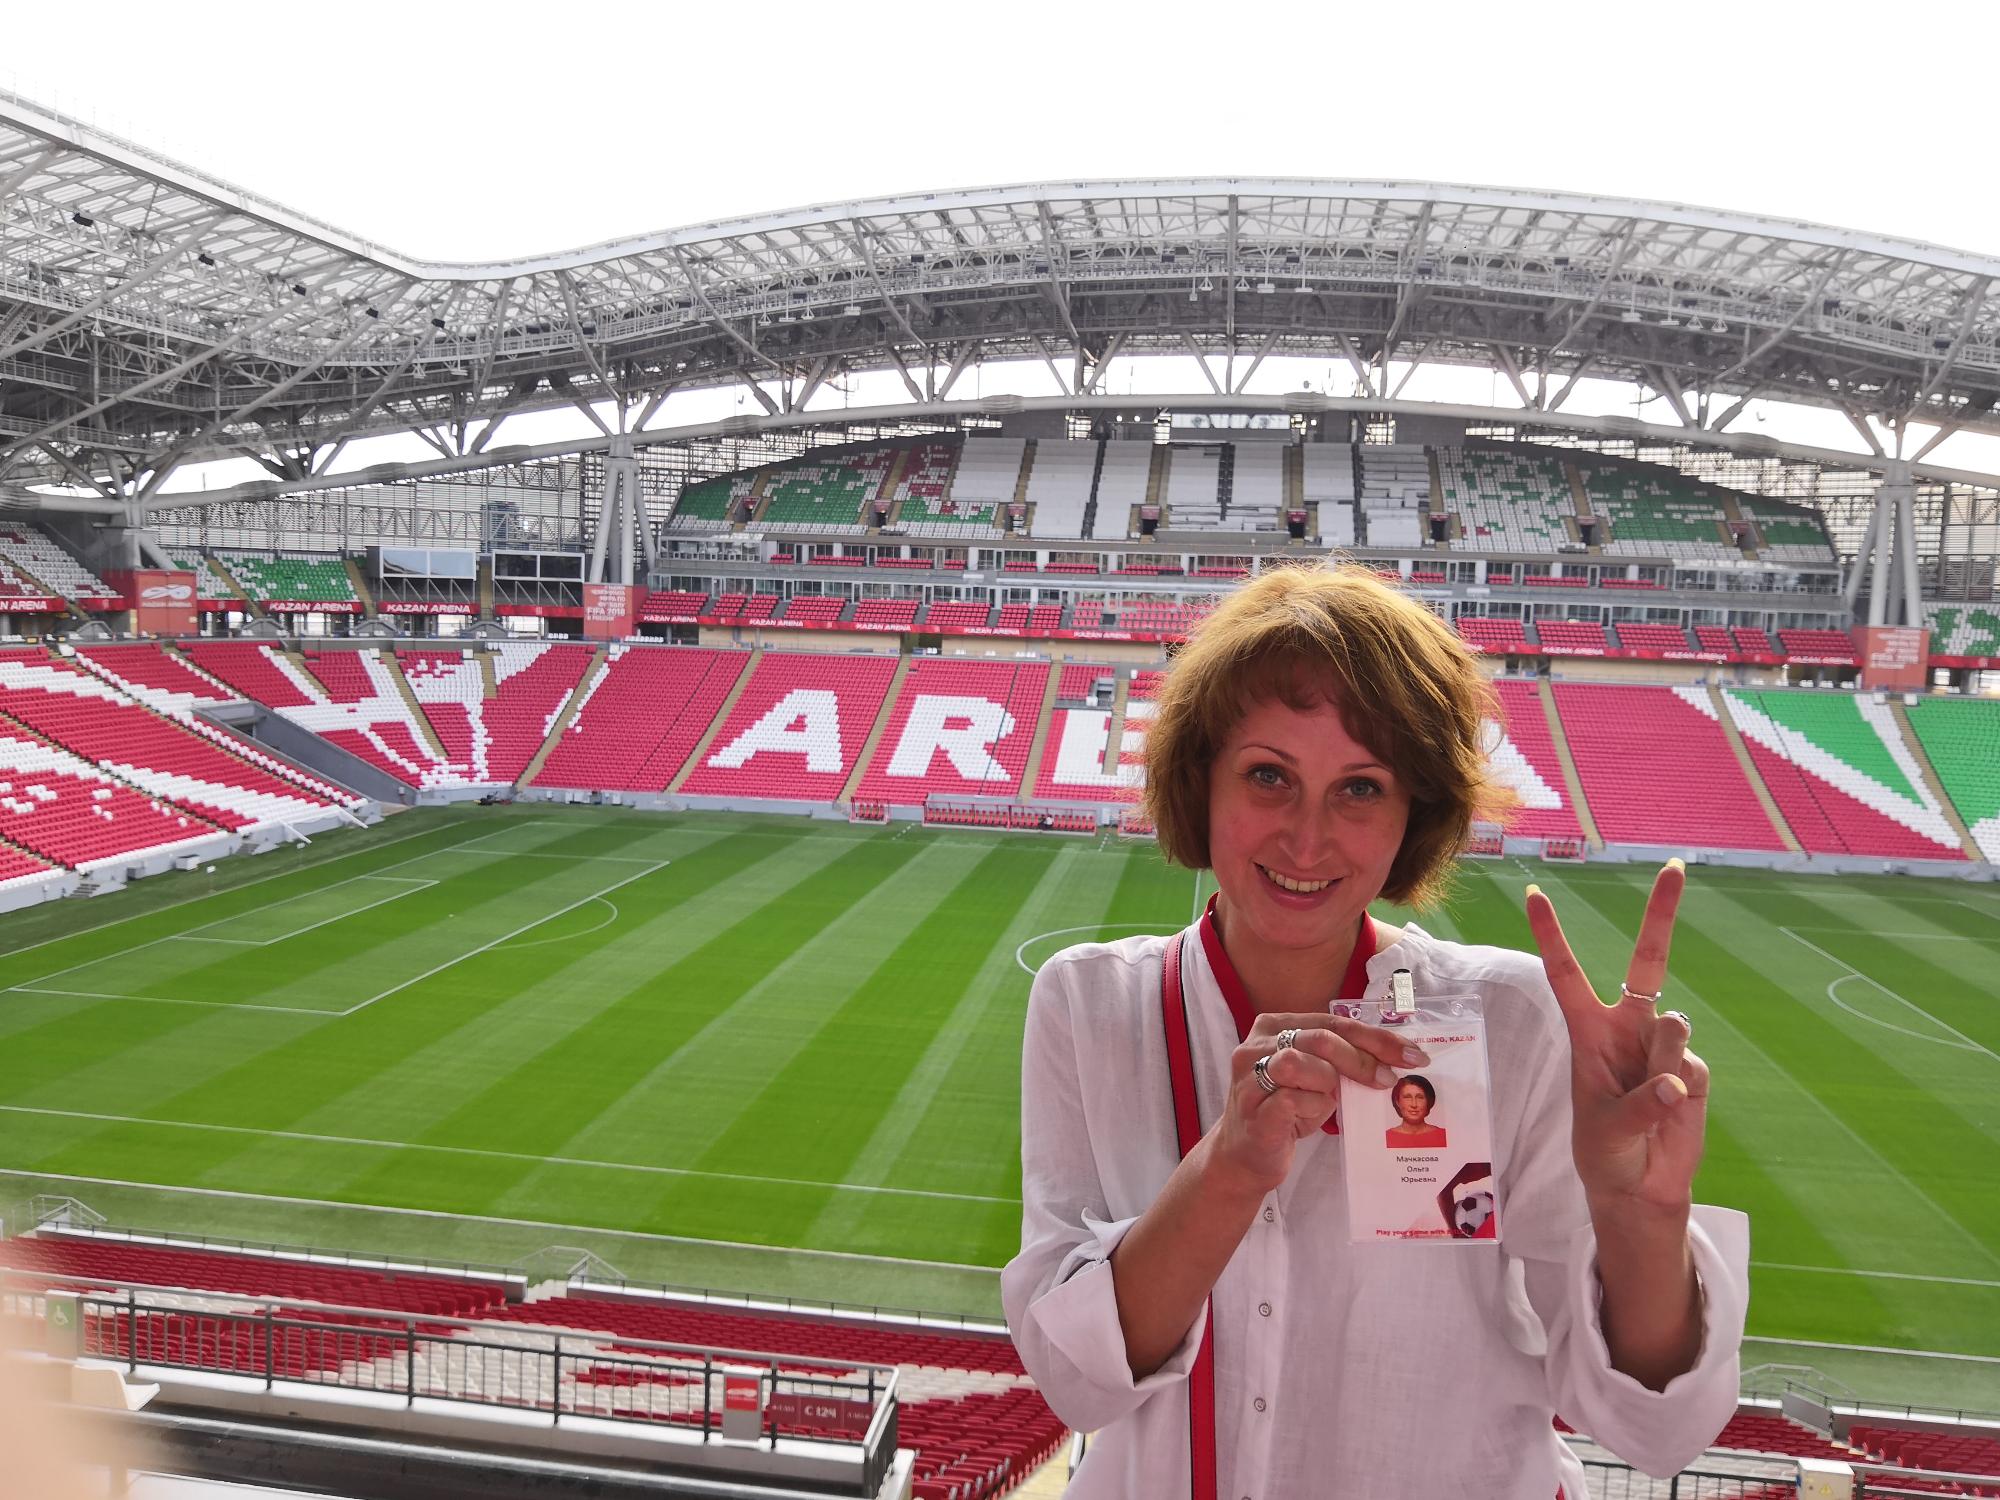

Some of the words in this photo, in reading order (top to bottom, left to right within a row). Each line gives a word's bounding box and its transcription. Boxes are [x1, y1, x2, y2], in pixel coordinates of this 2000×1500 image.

[11, 600, 47, 610] ARENA
[269, 602, 310, 611] KAZAN
[312, 602, 354, 611] ARENA
[387, 604, 428, 612] KAZAN
[430, 604, 471, 613] ARENA
[1414, 1036, 1448, 1044] UILDING,
[1401, 1176, 1437, 1184] Юрьевна
